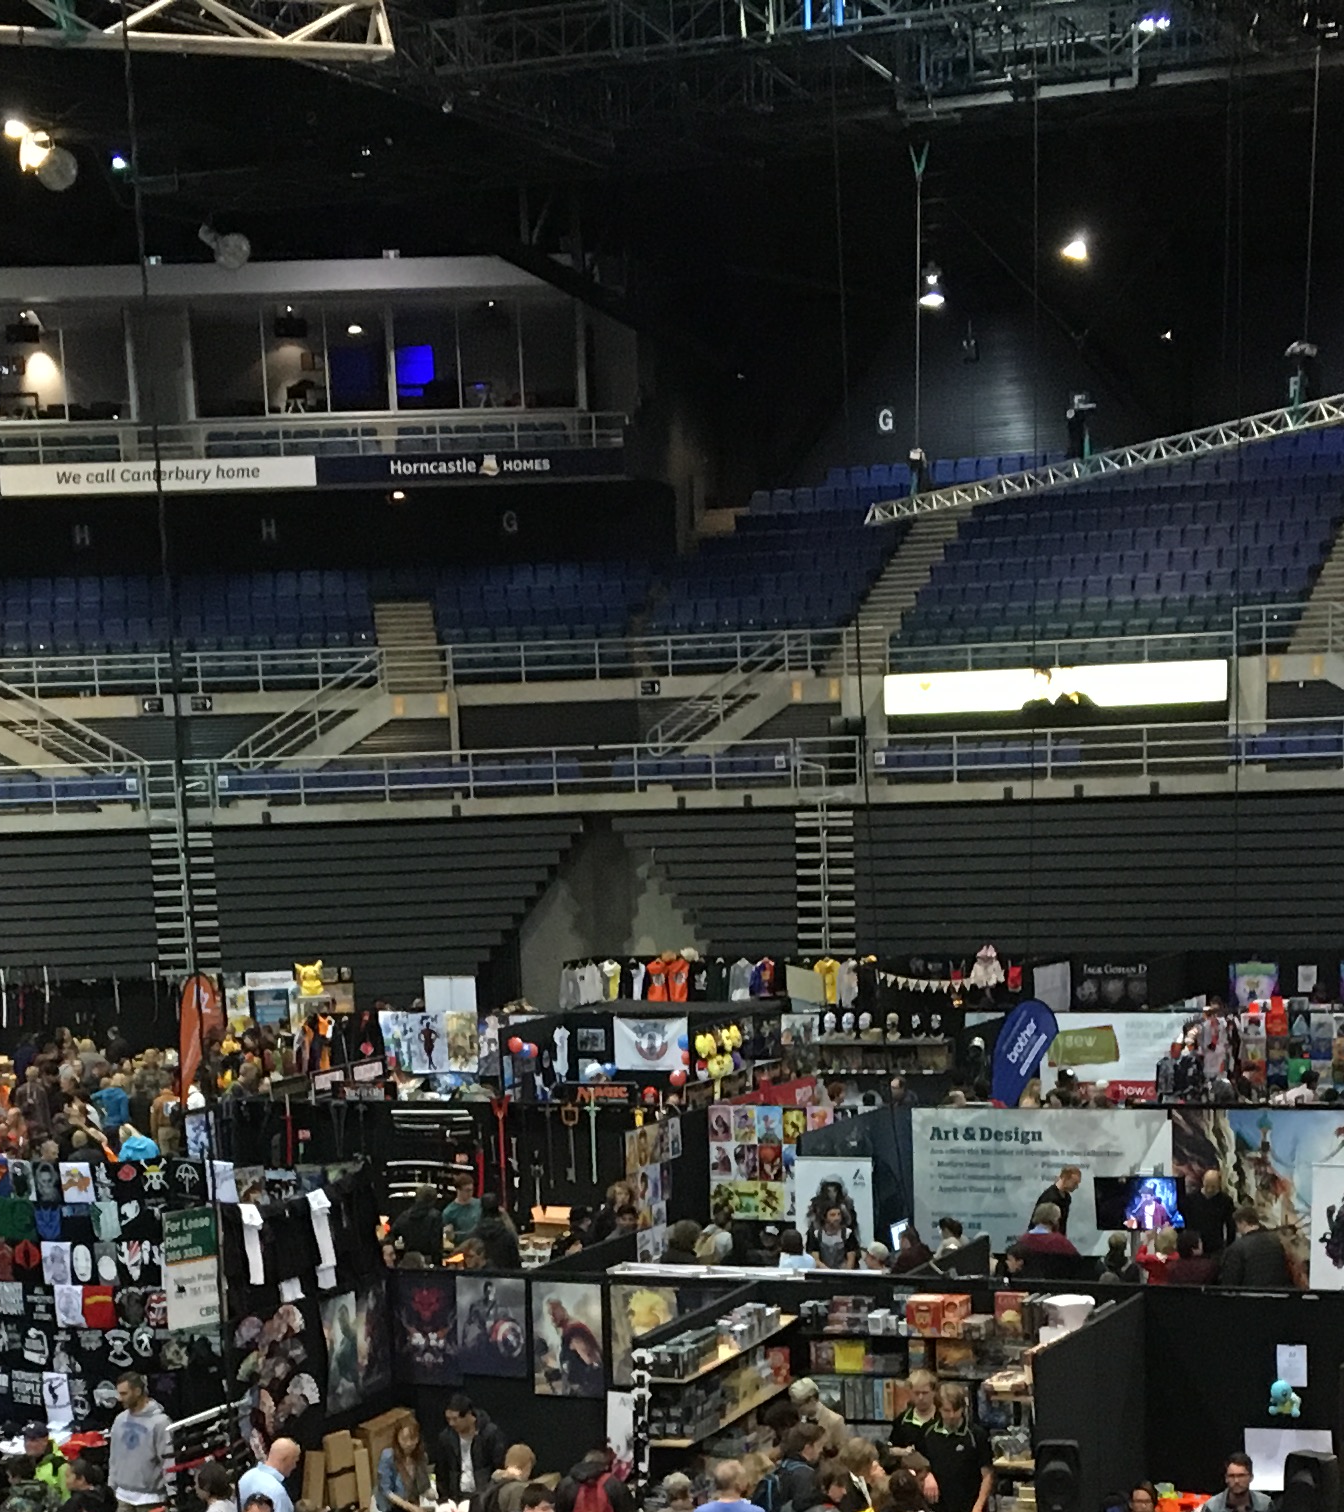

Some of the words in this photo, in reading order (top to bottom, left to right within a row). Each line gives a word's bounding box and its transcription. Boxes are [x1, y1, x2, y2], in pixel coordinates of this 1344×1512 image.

[878, 409, 894, 431] G
[56, 470, 83, 485] We
[86, 468, 116, 484] call
[120, 463, 212, 484] Canterbury
[216, 463, 261, 480] home
[390, 458, 477, 475] Horncastle
[503, 459, 550, 472] HOMES
[74, 525, 90, 546] H
[261, 518, 276, 541] H
[1007, 1018, 1038, 1065] brother
[930, 1127, 959, 1141] Art
[962, 1127, 976, 1141] &
[979, 1127, 1043, 1144] Design
[199, 1305, 219, 1317] CBR
